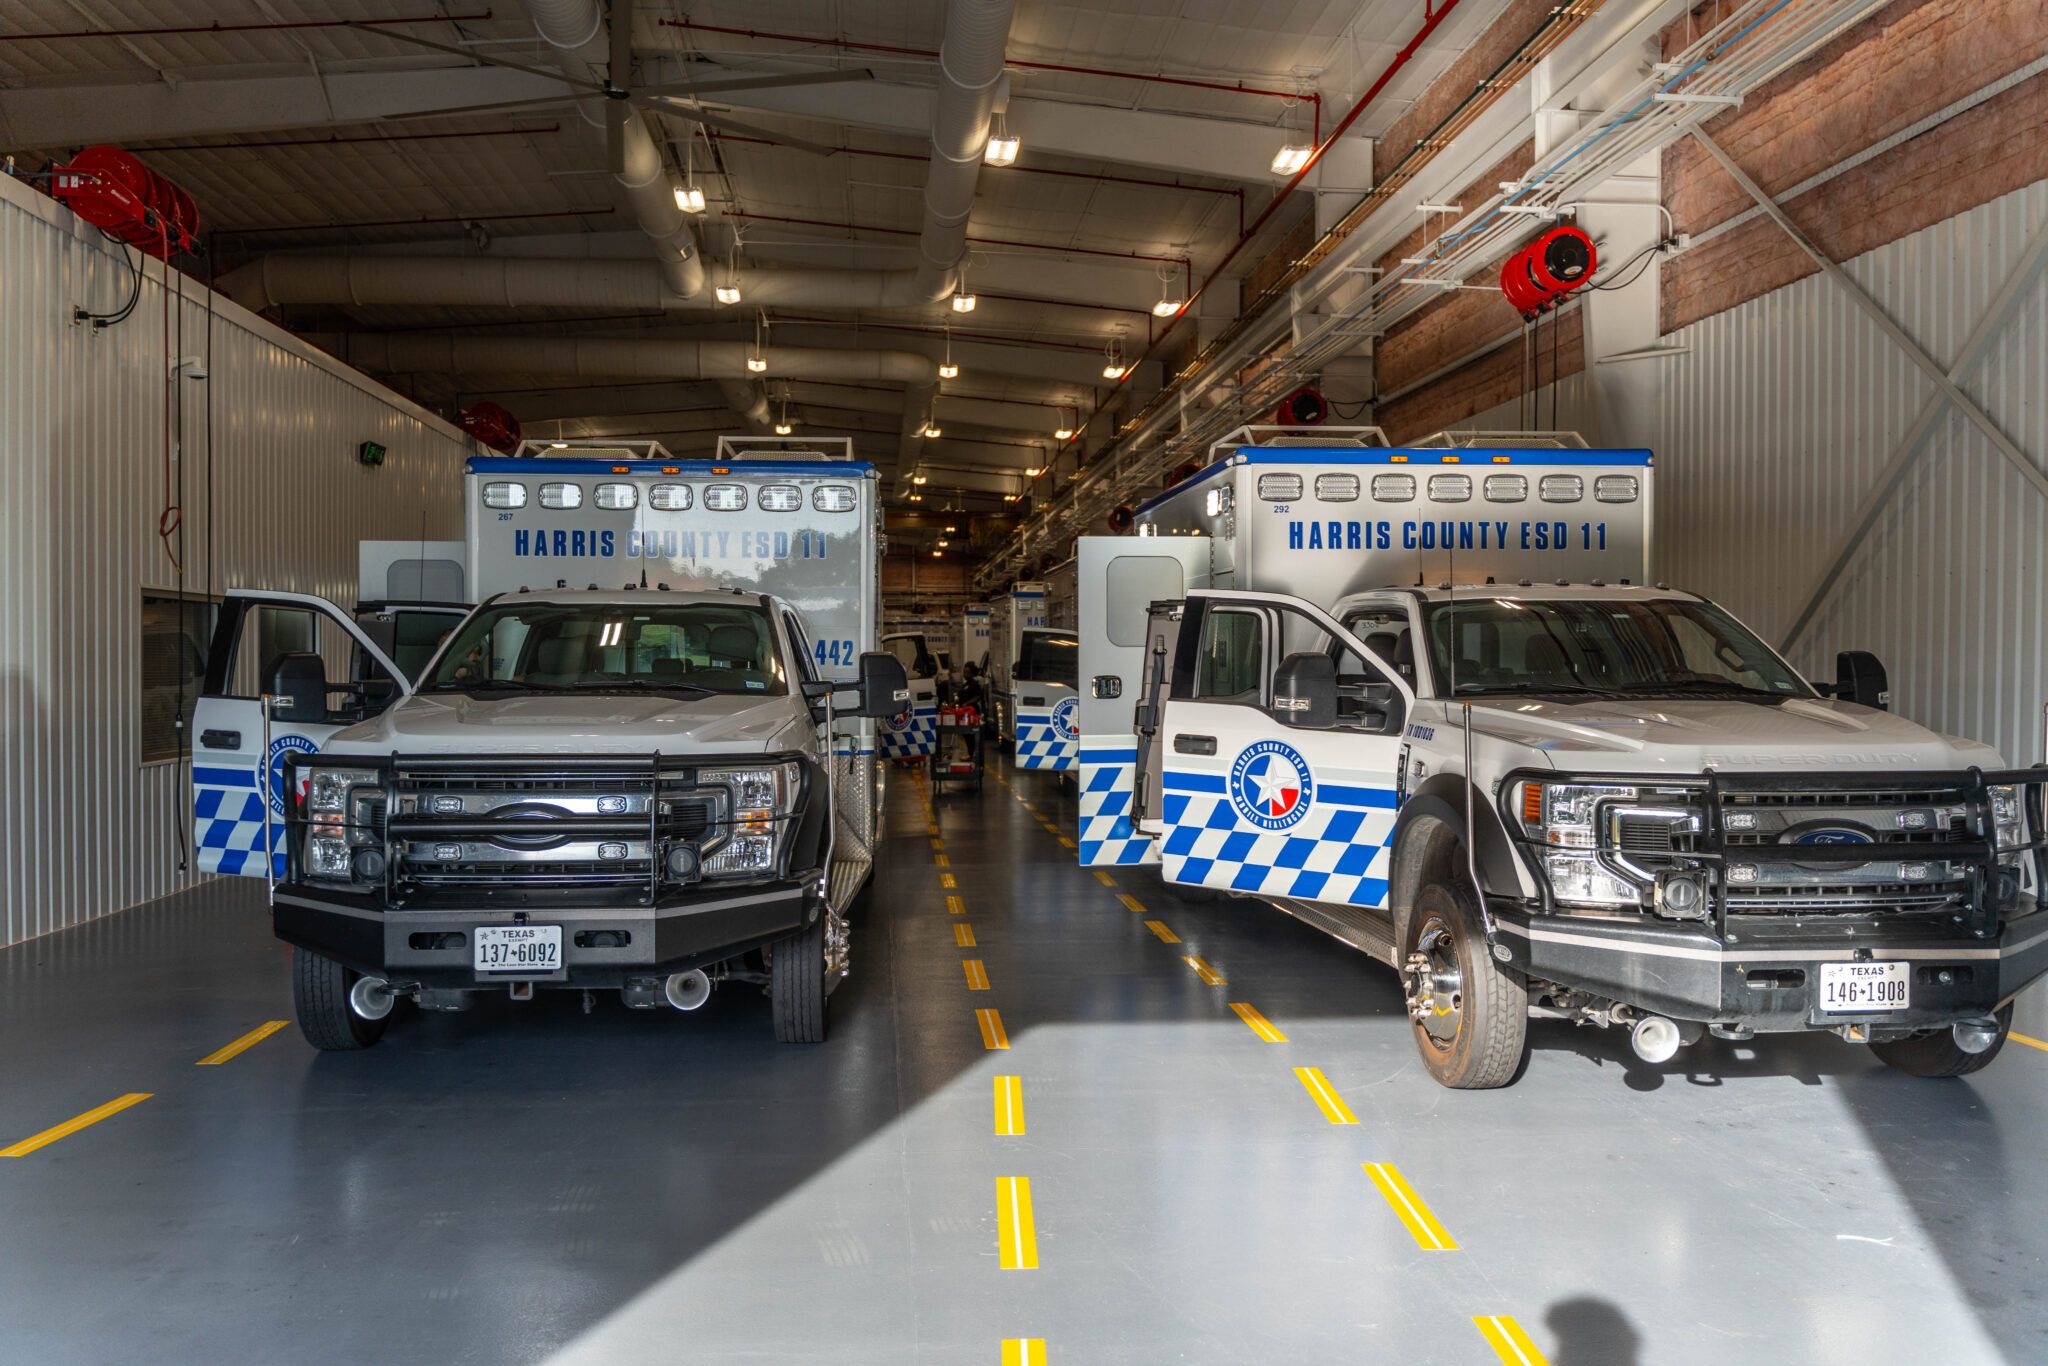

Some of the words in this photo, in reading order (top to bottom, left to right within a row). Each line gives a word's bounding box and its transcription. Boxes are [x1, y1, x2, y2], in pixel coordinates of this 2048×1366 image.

[1274, 505, 1290, 513] 292
[498, 513, 514, 521] 267
[1289, 521, 1391, 550] HARRIS
[1403, 521, 1509, 550] COUNTY
[1520, 522, 1568, 550] ESD
[1581, 522, 1607, 551] 11
[514, 529, 615, 557] HARRIS
[626, 530, 730, 559] COUNTY
[741, 531, 789, 559] ESD
[801, 532, 827, 560] 11
[1027, 616, 1045, 626] HAR
[815, 640, 853, 666] 442
[281, 738, 309, 750] COUNTY
[1233, 747, 1256, 777] HARRIS
[1257, 743, 1290, 756] COUNTY
[1290, 753, 1305, 770] ESD
[1301, 772, 1310, 782] 11
[1701, 752, 1827, 766] SUPER
[1832, 752, 1920, 765] DUTY
[1235, 795, 1260, 823] MOBILE
[1262, 801, 1308, 829] HEALTHCARE
[501, 930, 535, 939] TEXAS
[1850, 967, 1884, 976] TEXAS
